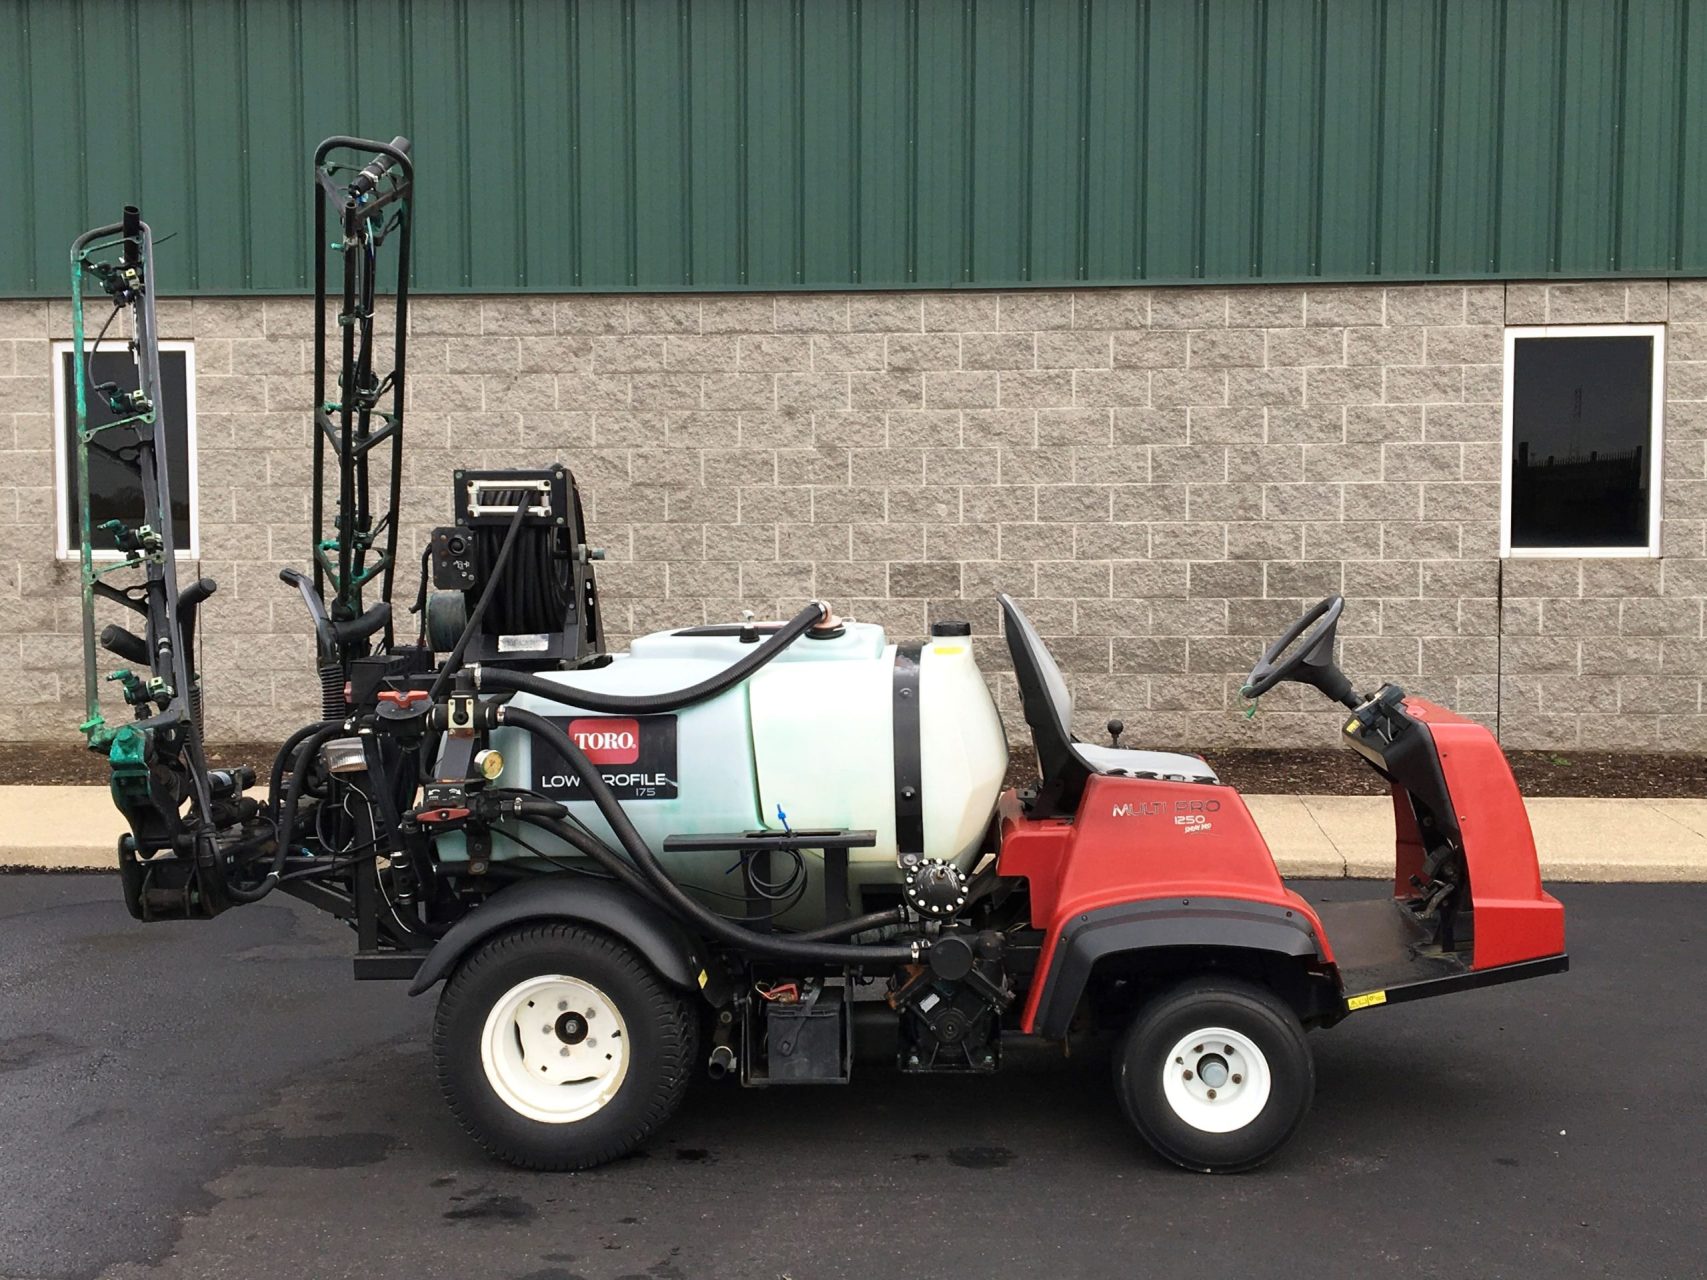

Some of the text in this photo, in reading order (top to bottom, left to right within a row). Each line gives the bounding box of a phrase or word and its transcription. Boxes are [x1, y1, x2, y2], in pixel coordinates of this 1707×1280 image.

[574, 731, 634, 750] TORO
[541, 773, 666, 788] LOW ROFILE
[635, 787, 656, 797] 175
[1112, 800, 1221, 817] MULTI PRO
[1174, 815, 1206, 825] 1250
